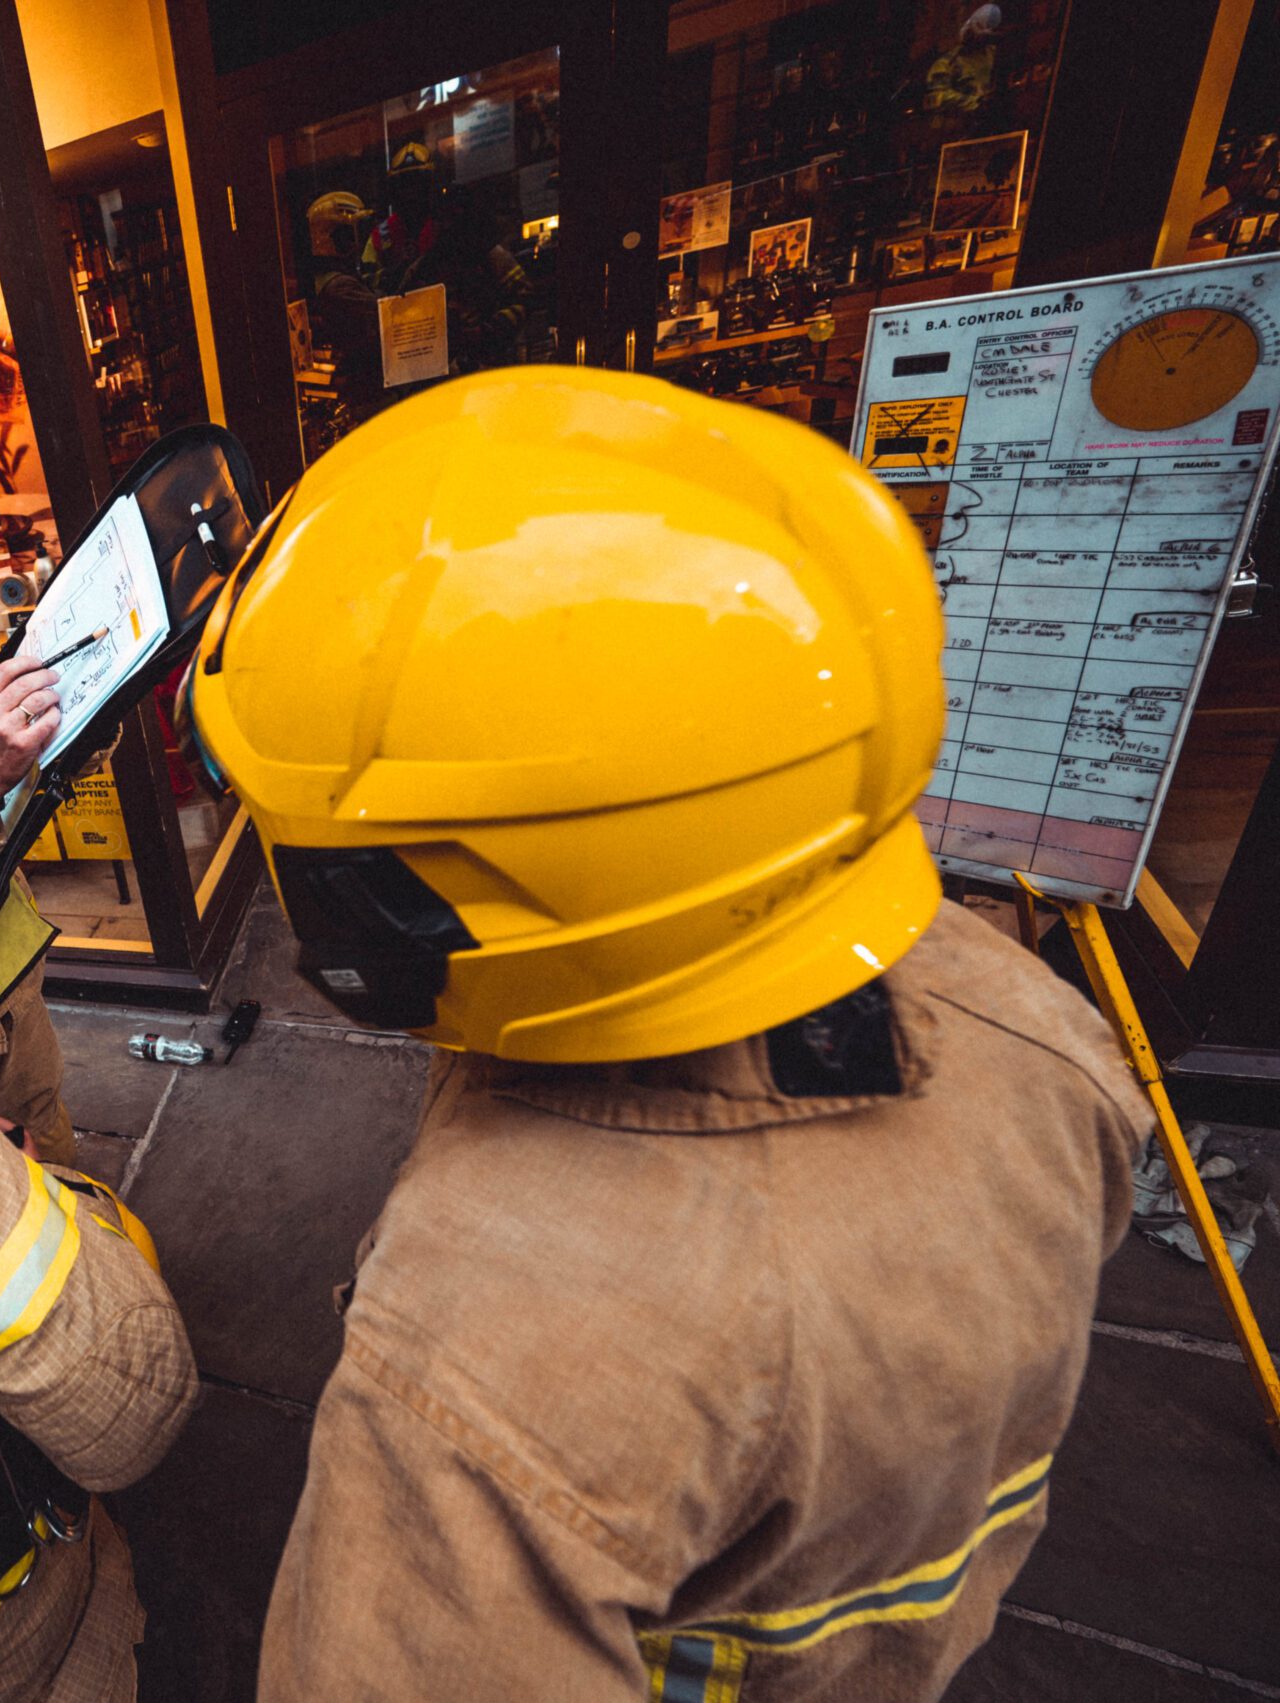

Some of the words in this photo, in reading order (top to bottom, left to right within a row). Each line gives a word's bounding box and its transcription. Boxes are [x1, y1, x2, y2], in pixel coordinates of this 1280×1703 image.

[926, 320, 951, 331] B.A.
[958, 309, 1024, 326] CONTROL
[1030, 300, 1084, 318] BOARD
[979, 336, 1001, 345] ENTRY
[1004, 333, 1037, 343] CONTROL
[1041, 329, 1073, 338] OFFICER
[974, 361, 1009, 370] LOCATION
[1130, 441, 1148, 449] MAY
[1148, 440, 1181, 448] REDUCE
[1182, 437, 1224, 446] DURATION
[1049, 462, 1093, 470] LOCATION
[1173, 461, 1221, 469] REMARKS
[1182, 615, 1197, 627] 2
[75, 790, 109, 798] MPTIES
